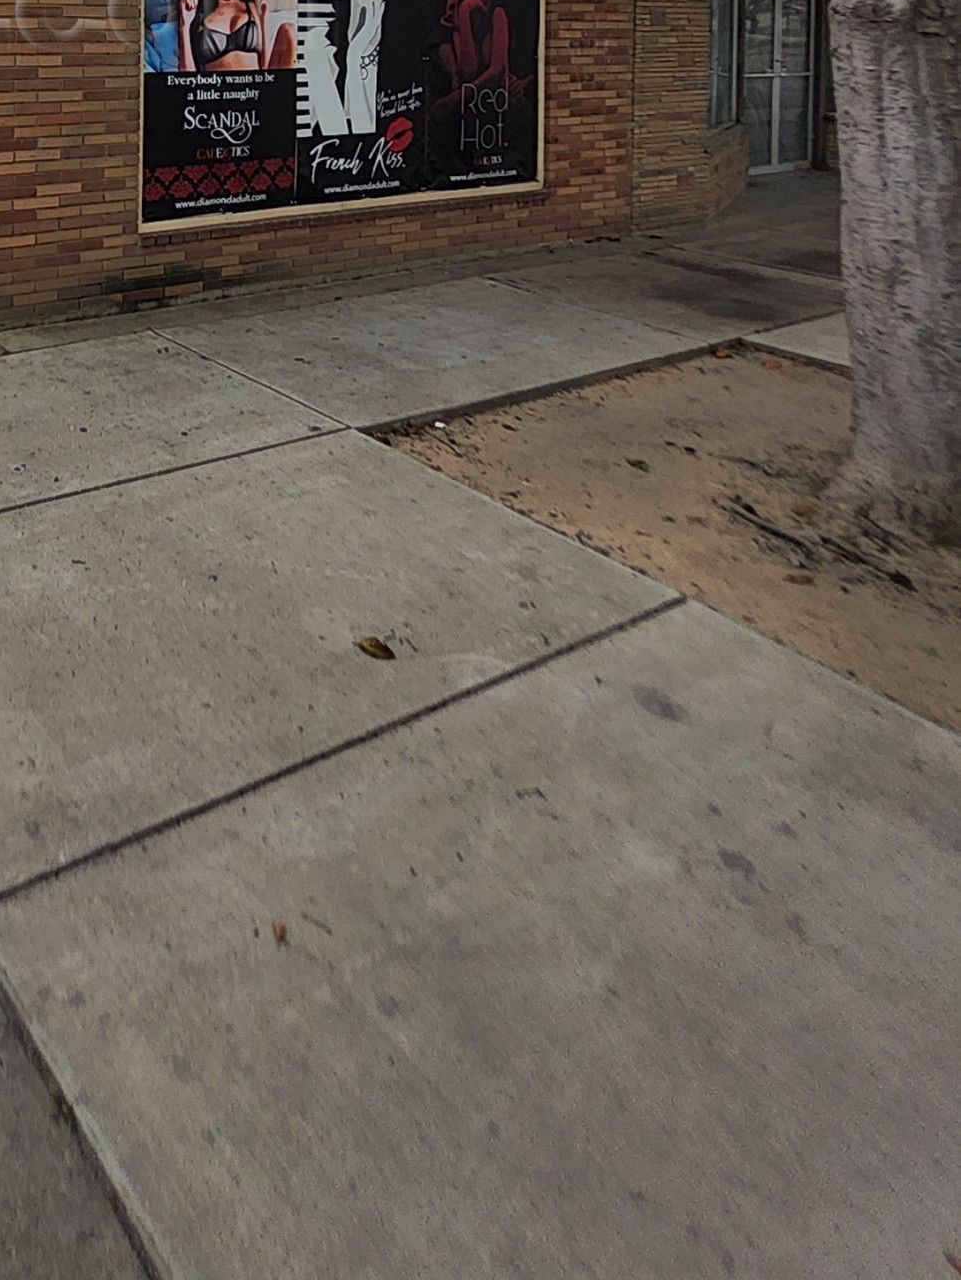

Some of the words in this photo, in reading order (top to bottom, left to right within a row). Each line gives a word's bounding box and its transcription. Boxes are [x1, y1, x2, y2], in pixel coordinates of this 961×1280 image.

[167, 74, 223, 88] Everybody
[226, 74, 253, 84] wants
[254, 73, 264, 82] to
[264, 72, 275, 82] be
[187, 92, 194, 100] a
[196, 90, 220, 100] little
[222, 89, 260, 101] naughty
[461, 74, 509, 114] Red
[310, 138, 365, 184] French
[368, 136, 406, 179] Kiss.
[174, 193, 266, 210] www.diamondadult.com
